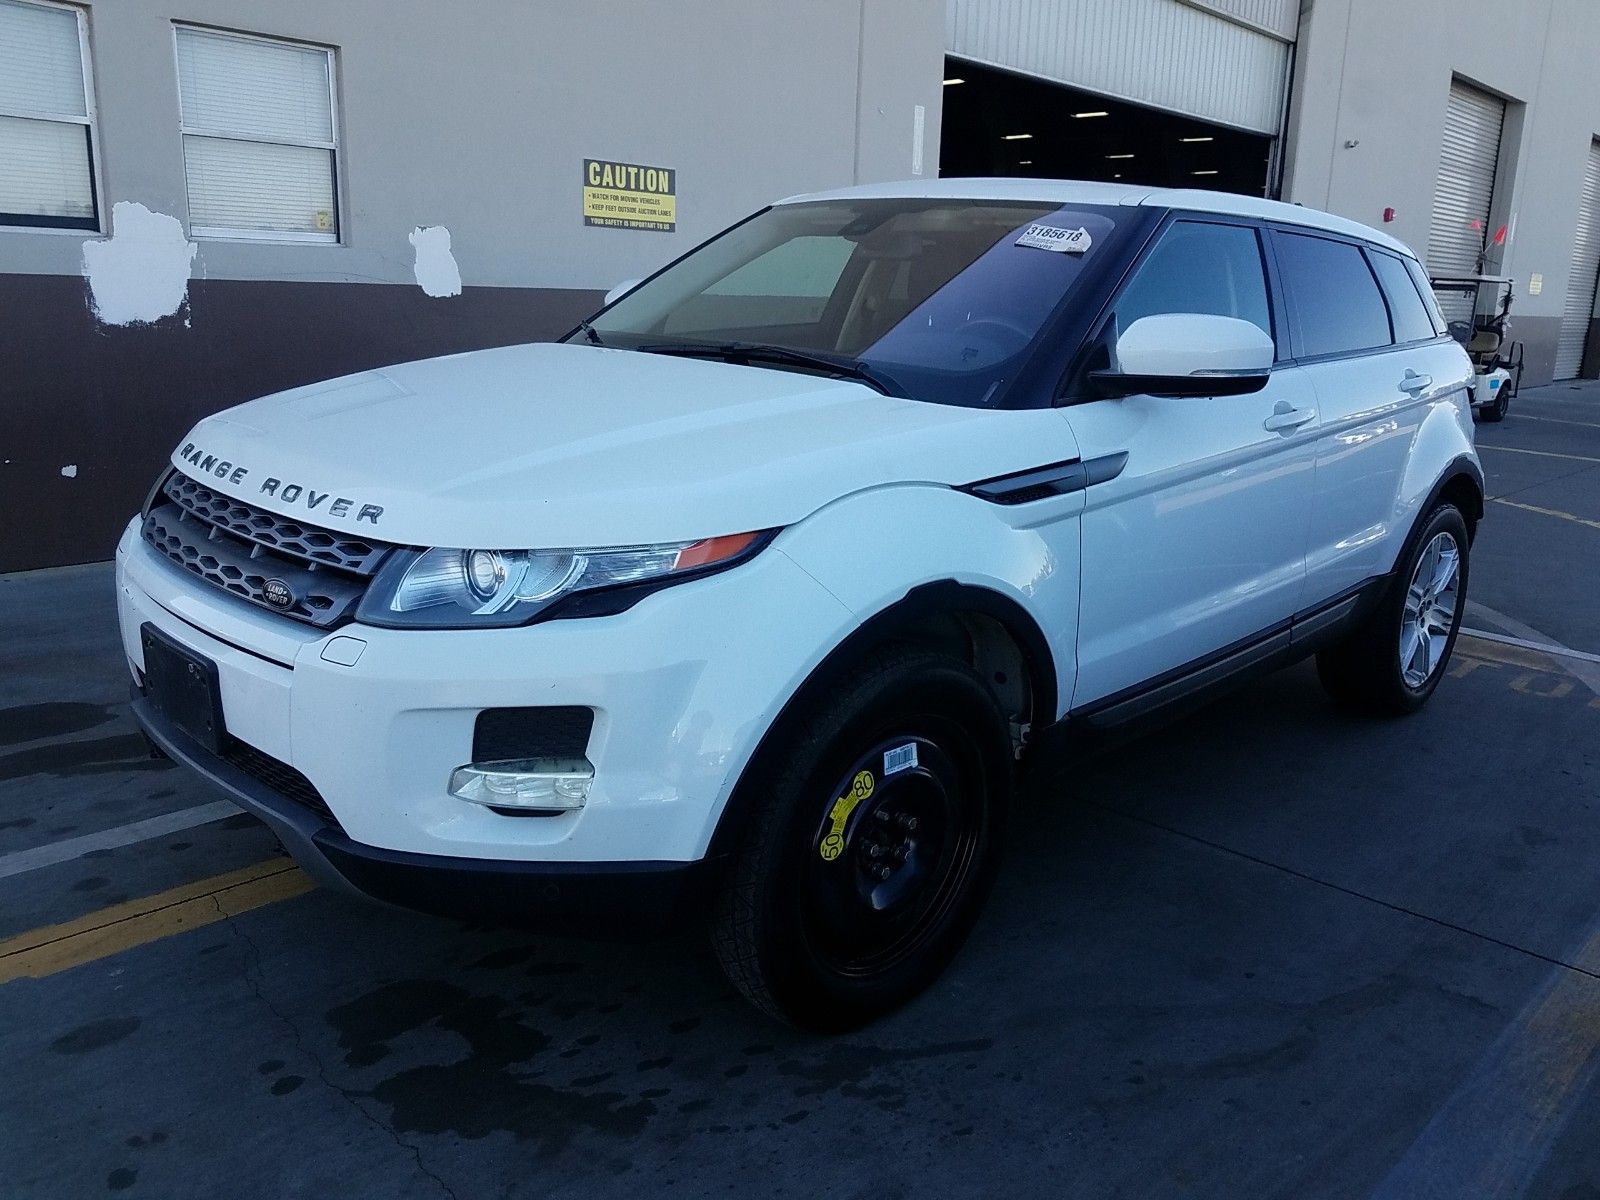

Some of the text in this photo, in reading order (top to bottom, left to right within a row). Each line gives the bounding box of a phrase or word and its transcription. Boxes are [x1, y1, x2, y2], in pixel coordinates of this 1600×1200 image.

[589, 161, 669, 193] CAUTION
[620, 195, 638, 203] MOVING
[640, 197, 661, 206] VEHICLES
[605, 204, 617, 212] FEET
[618, 206, 636, 214] OUTSIDE
[630, 221, 656, 229] IMPORTANT
[1026, 226, 1082, 241] 3185618
[180, 442, 384, 525] RANGE ROVER
[268, 584, 283, 595] LAND
[269, 592, 288, 605] ROVER
[854, 773, 873, 797] 80
[825, 833, 840, 859] 50
